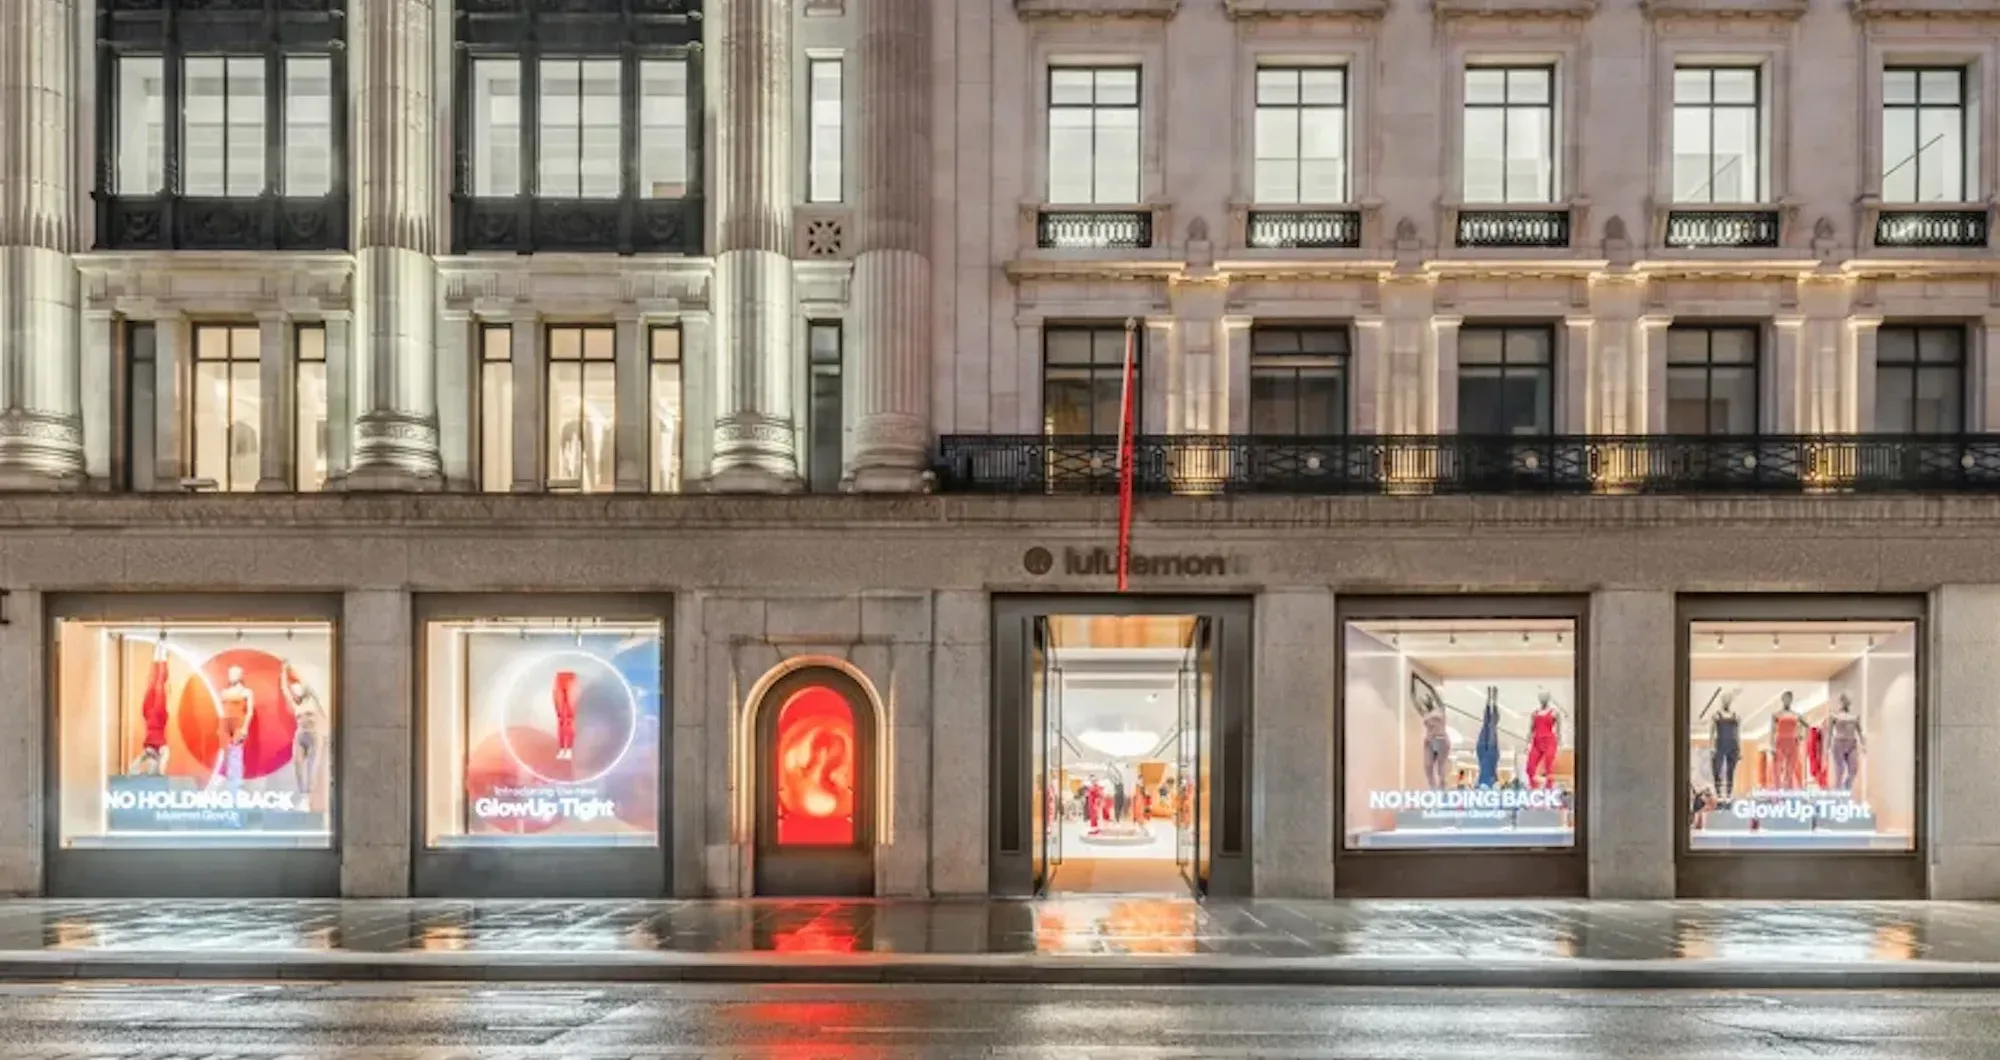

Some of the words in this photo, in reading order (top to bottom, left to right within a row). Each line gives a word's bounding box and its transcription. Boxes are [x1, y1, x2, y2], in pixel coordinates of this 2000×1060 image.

[1065, 546, 1225, 575] luluemon
[104, 790, 136, 809] NO
[139, 790, 234, 809] HOLDING
[236, 790, 294, 809] BACK
[475, 798, 558, 821] GlowUp
[560, 798, 615, 821] Tight
[1370, 790, 1400, 808] NO
[1405, 790, 1501, 808] HOLDING
[1504, 790, 1562, 808] BACK
[1733, 800, 1816, 821] GlowUp
[1818, 800, 1871, 821] Tight
